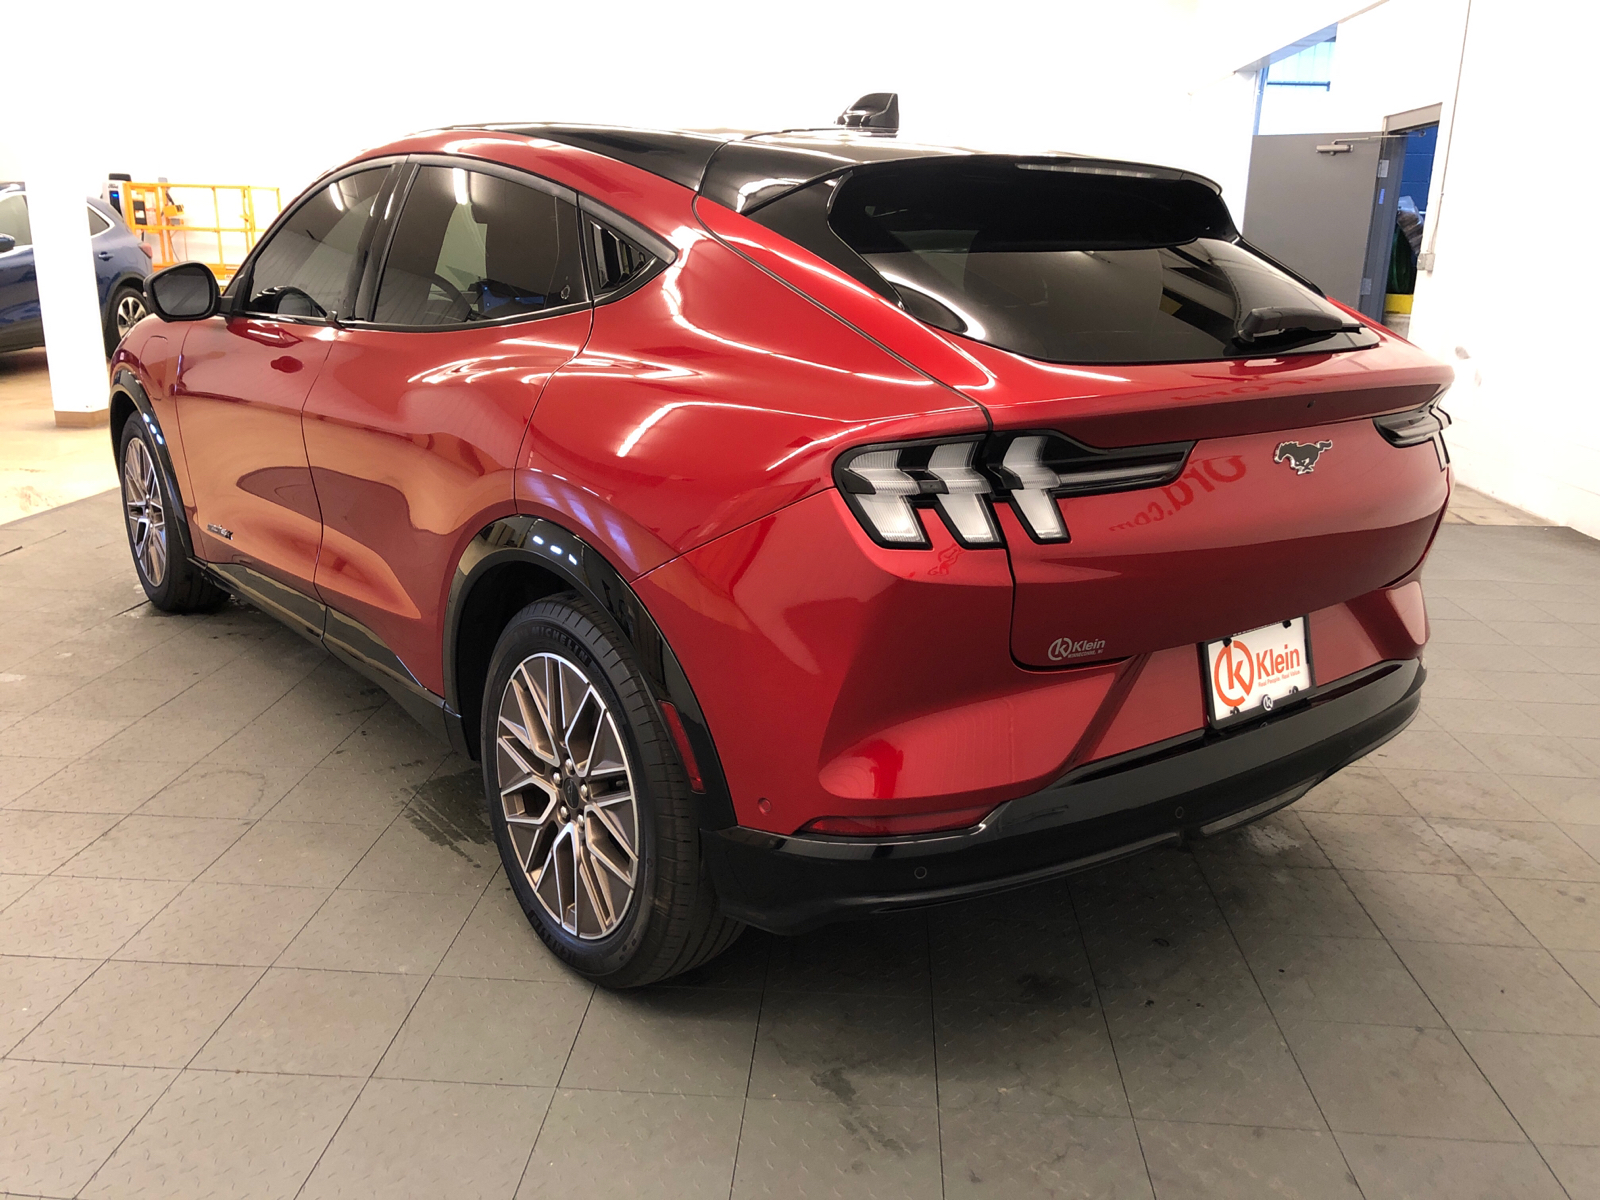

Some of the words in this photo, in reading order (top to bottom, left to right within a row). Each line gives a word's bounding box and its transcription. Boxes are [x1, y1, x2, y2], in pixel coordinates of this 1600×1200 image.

[531, 626, 589, 666] MICHELIN
[1072, 638, 1106, 652] Klein
[1256, 643, 1300, 680] Klein
